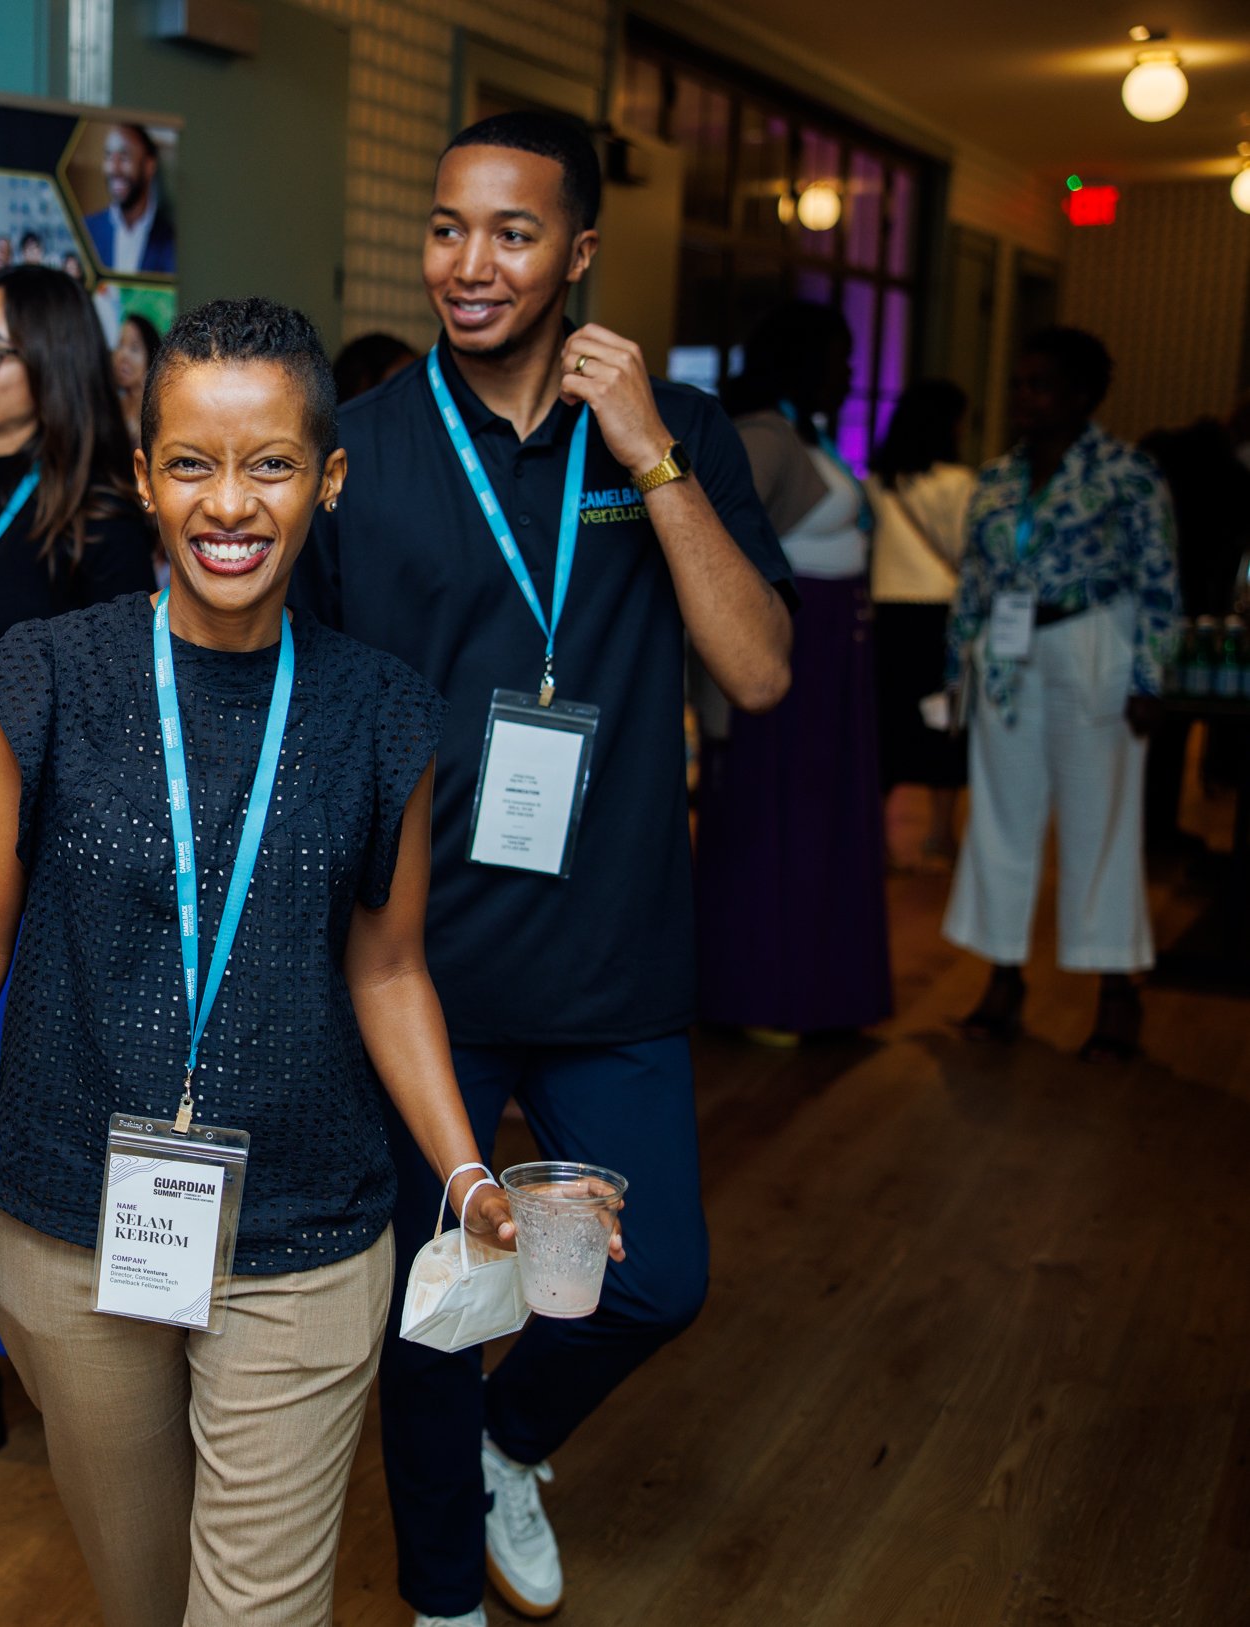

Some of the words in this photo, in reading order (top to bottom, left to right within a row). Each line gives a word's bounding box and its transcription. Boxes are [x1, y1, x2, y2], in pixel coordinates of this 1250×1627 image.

[579, 487, 643, 510] CAMELBA
[580, 505, 649, 525] venture
[153, 1188, 182, 1199] SUMMIT
[154, 1176, 216, 1196] GUARDIAN
[116, 1202, 138, 1211] NAME
[115, 1211, 174, 1231] SELAM
[114, 1226, 189, 1249] KEBROM
[112, 1254, 147, 1265] COMPANY
[110, 1270, 134, 1279] Director,
[134, 1274, 164, 1283] Conscious
[111, 1263, 142, 1273] Camelback
[143, 1268, 168, 1277] Ventures
[110, 1277, 140, 1286] Camelback
[141, 1282, 171, 1292] Fellowship
